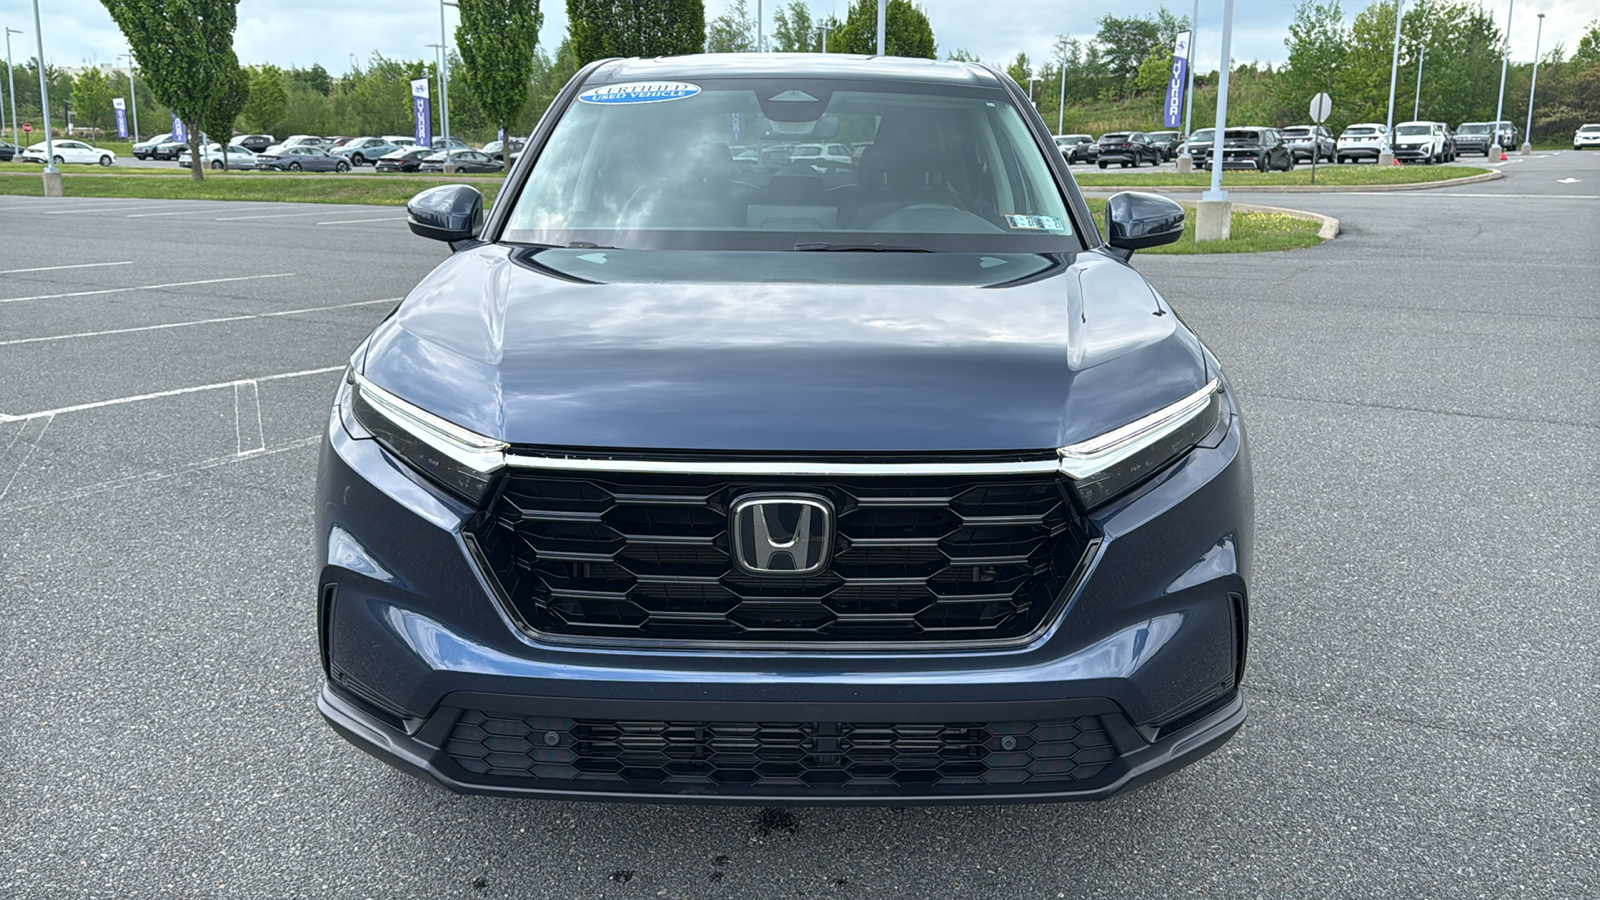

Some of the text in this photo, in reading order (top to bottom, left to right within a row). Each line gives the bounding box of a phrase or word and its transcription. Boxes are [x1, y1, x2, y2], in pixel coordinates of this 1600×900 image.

[592, 90, 686, 101] USED VEHICLE
[1169, 60, 1182, 125] HYUNDAI
[416, 98, 426, 145] HYUNDAI
